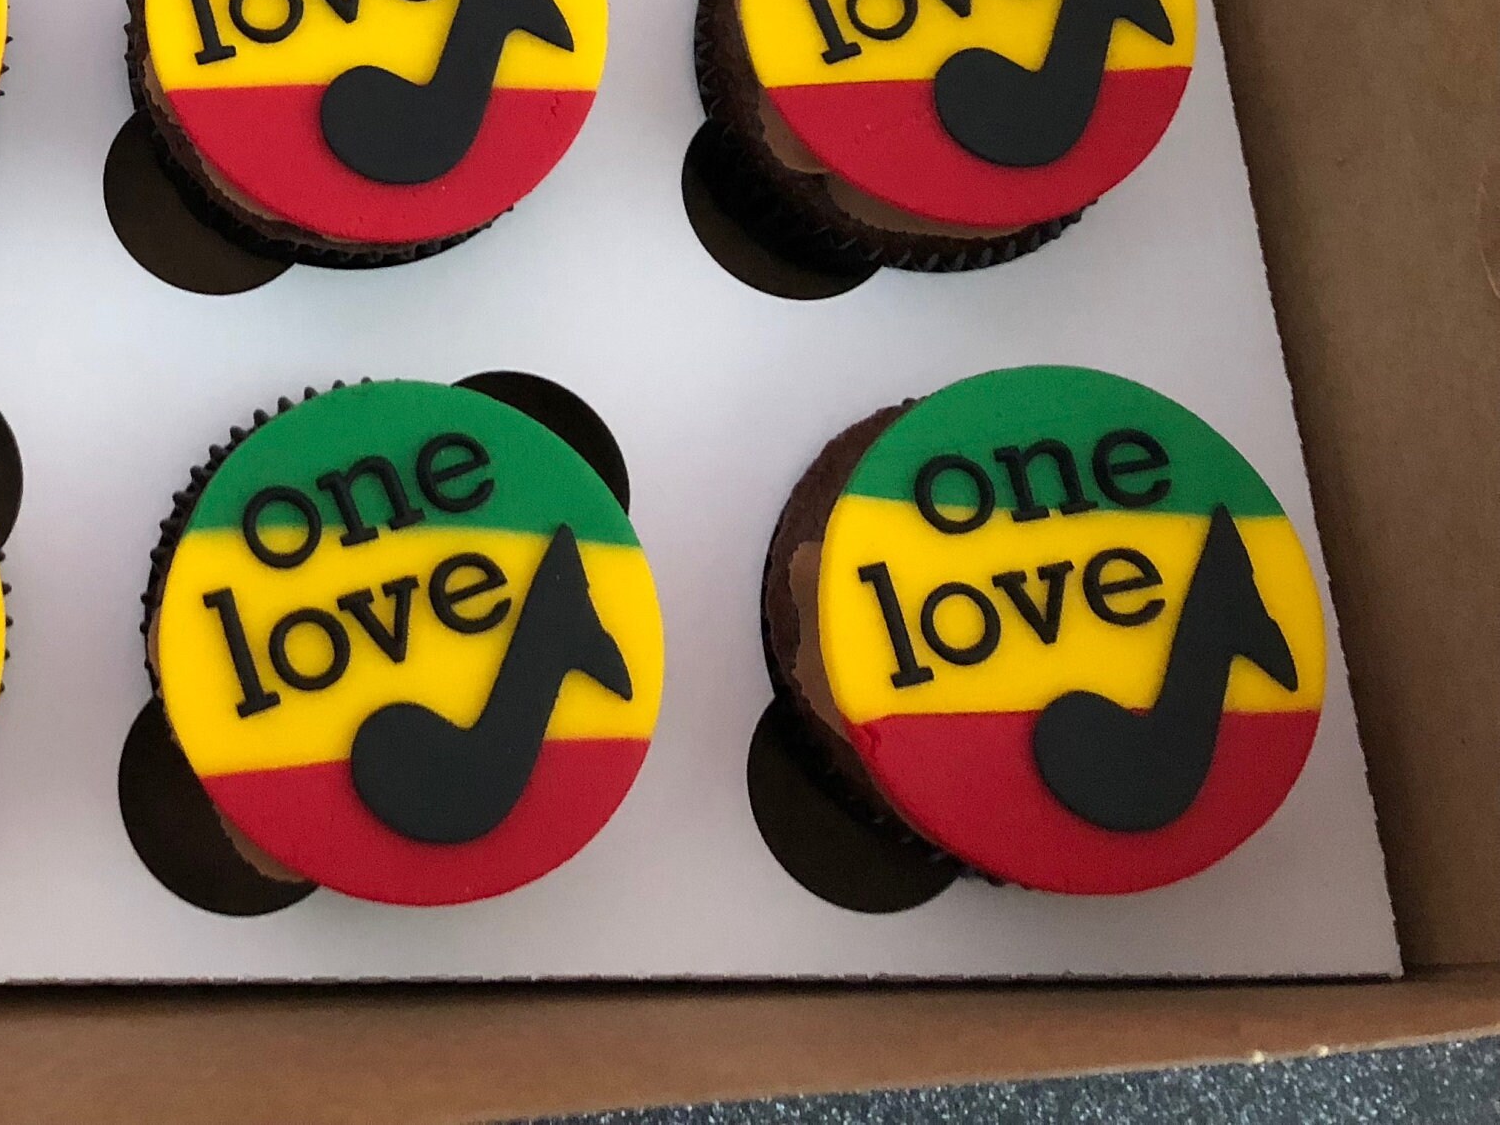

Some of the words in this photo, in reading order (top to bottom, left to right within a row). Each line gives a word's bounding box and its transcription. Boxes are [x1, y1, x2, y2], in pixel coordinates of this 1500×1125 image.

[241, 433, 494, 568] one
[913, 428, 1171, 533] one
[204, 555, 510, 717] love
[859, 549, 1164, 687] love
